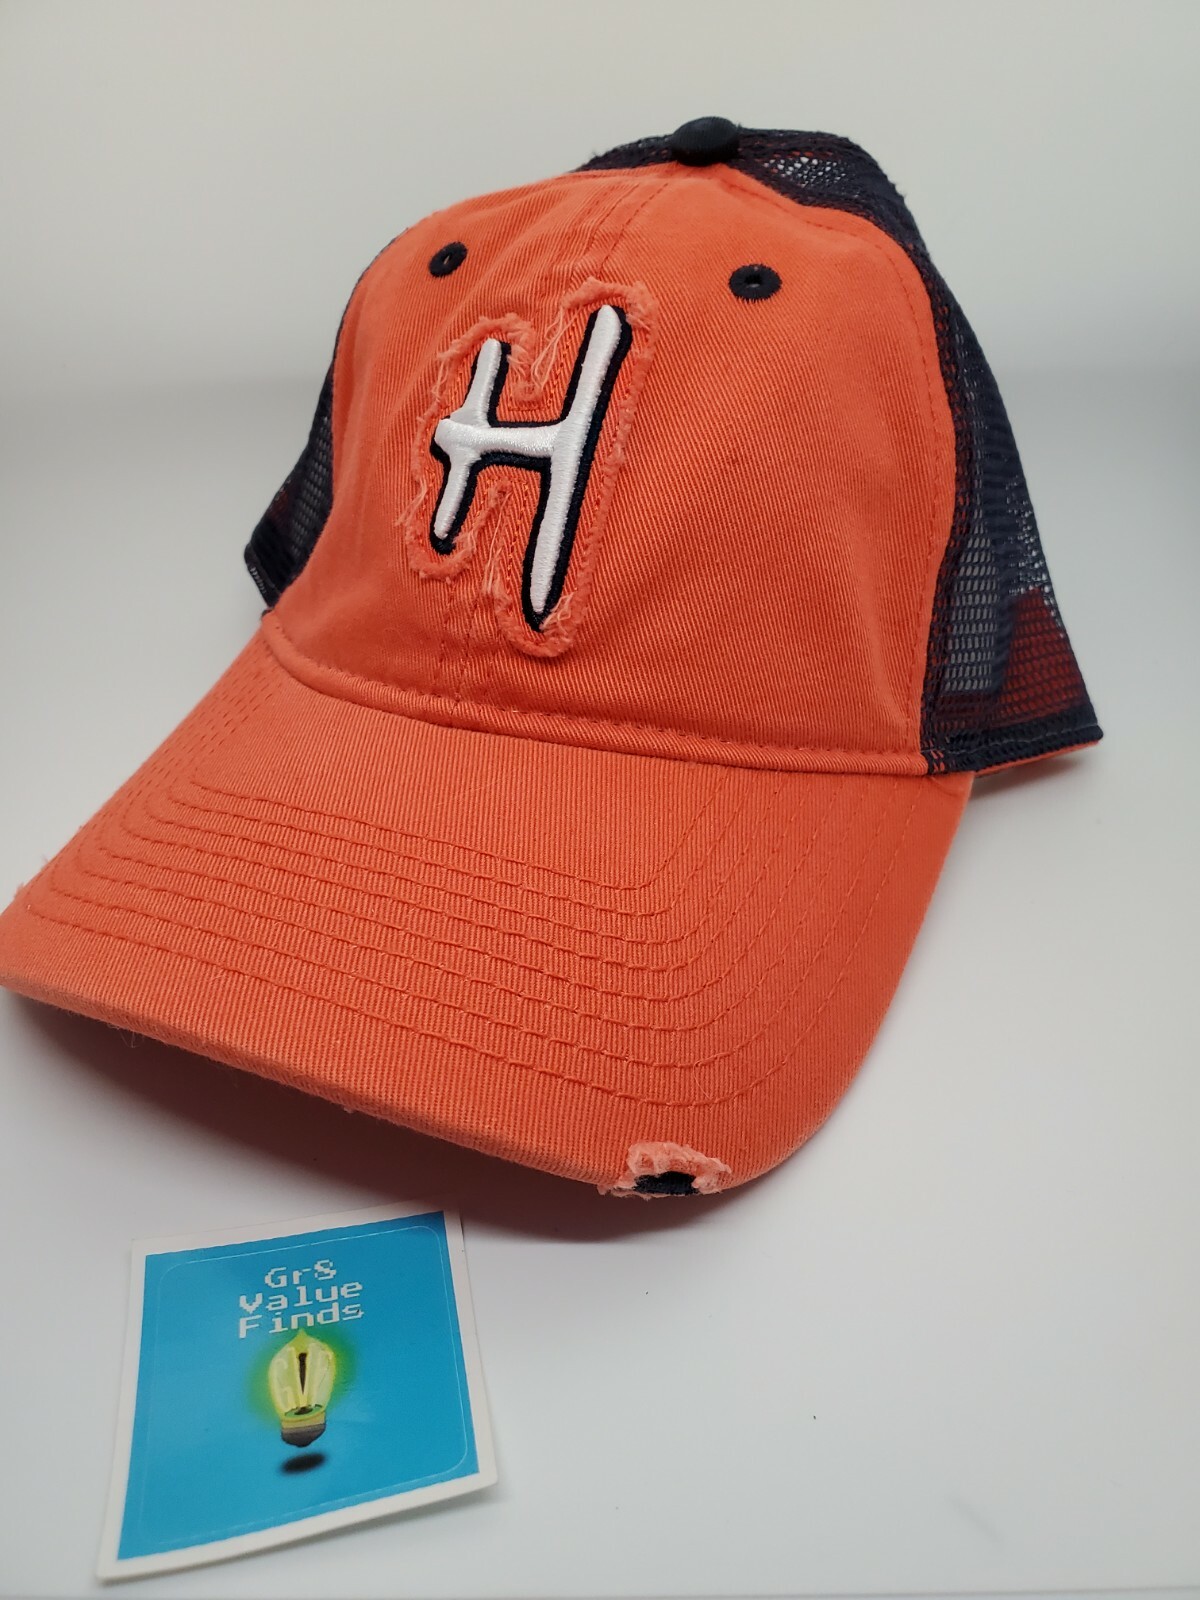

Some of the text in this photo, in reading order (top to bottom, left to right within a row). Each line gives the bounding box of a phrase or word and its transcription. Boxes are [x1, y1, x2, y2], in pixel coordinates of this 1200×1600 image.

[431, 304, 633, 632] H
[264, 1259, 337, 1289] Gr8
[239, 1281, 363, 1314] Value
[238, 1302, 365, 1339] Finds
